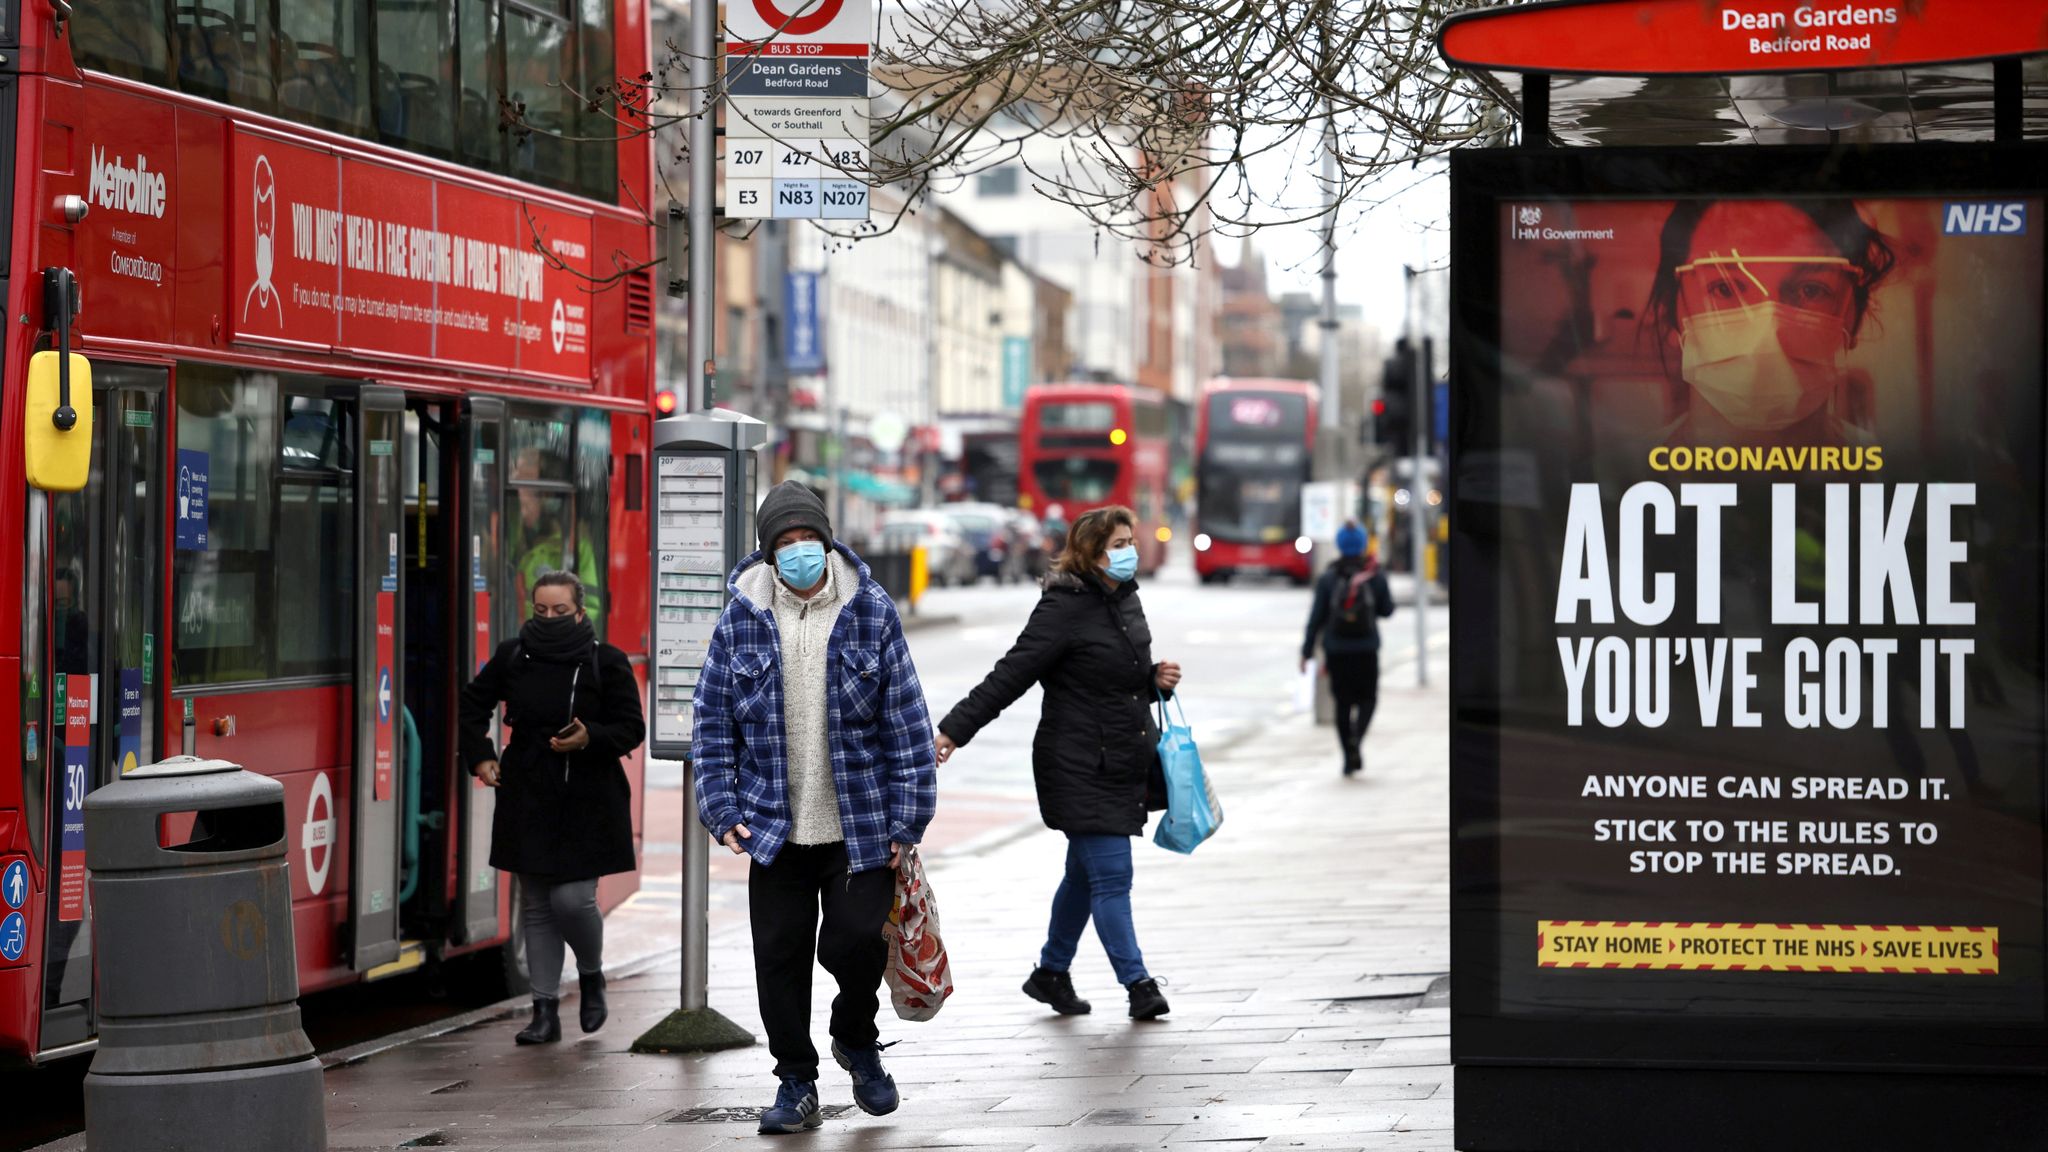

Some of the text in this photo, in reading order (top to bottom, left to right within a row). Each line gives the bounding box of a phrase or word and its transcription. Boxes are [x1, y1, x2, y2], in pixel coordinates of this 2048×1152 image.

[1722, 4, 1897, 30] Dean Gardens
[771, 45, 823, 54] BUS STOP
[1750, 34, 1871, 54] Bedford Road
[752, 63, 842, 76] Dean Gardens
[765, 79, 829, 88] Bedford Road
[754, 108, 842, 117] towards Greenford
[784, 121, 823, 129] Southall
[734, 151, 763, 164] 207
[782, 151, 812, 165] 427
[831, 151, 861, 165] 483
[88, 143, 166, 219] Metroline
[739, 190, 758, 204] E3
[780, 191, 813, 205] N83
[823, 191, 866, 206] N207
[1945, 204, 2024, 232] NHS
[1518, 228, 1614, 239] HM Government
[292, 202, 544, 303] YOU MUST WEAR A FACE COVERING ON PUBLIC TRANSPORT
[293, 282, 299, 304] If
[299, 288, 310, 309] you
[311, 287, 319, 307] do
[358, 294, 366, 314] be
[1648, 446, 1884, 472] CORONAVIRUS
[1554, 481, 1976, 626] ACT LIKE
[1556, 635, 1975, 729] YOU'VE GOT IT
[124, 688, 140, 700] Fares in
[68, 697, 89, 708] Maximum
[122, 705, 140, 719] operation
[69, 714, 87, 728] capacity
[66, 764, 85, 811] 30
[1581, 775, 1950, 800] ANYONE CAN SPREAD IT.
[64, 823, 84, 834] passengers
[1594, 819, 1938, 845] STICK TO THE RULES TO
[1629, 851, 1901, 876] STOP THE SPREAD.
[1553, 936, 1983, 959] STAY HOME PROTECT THE NHS SAVE LIVES
